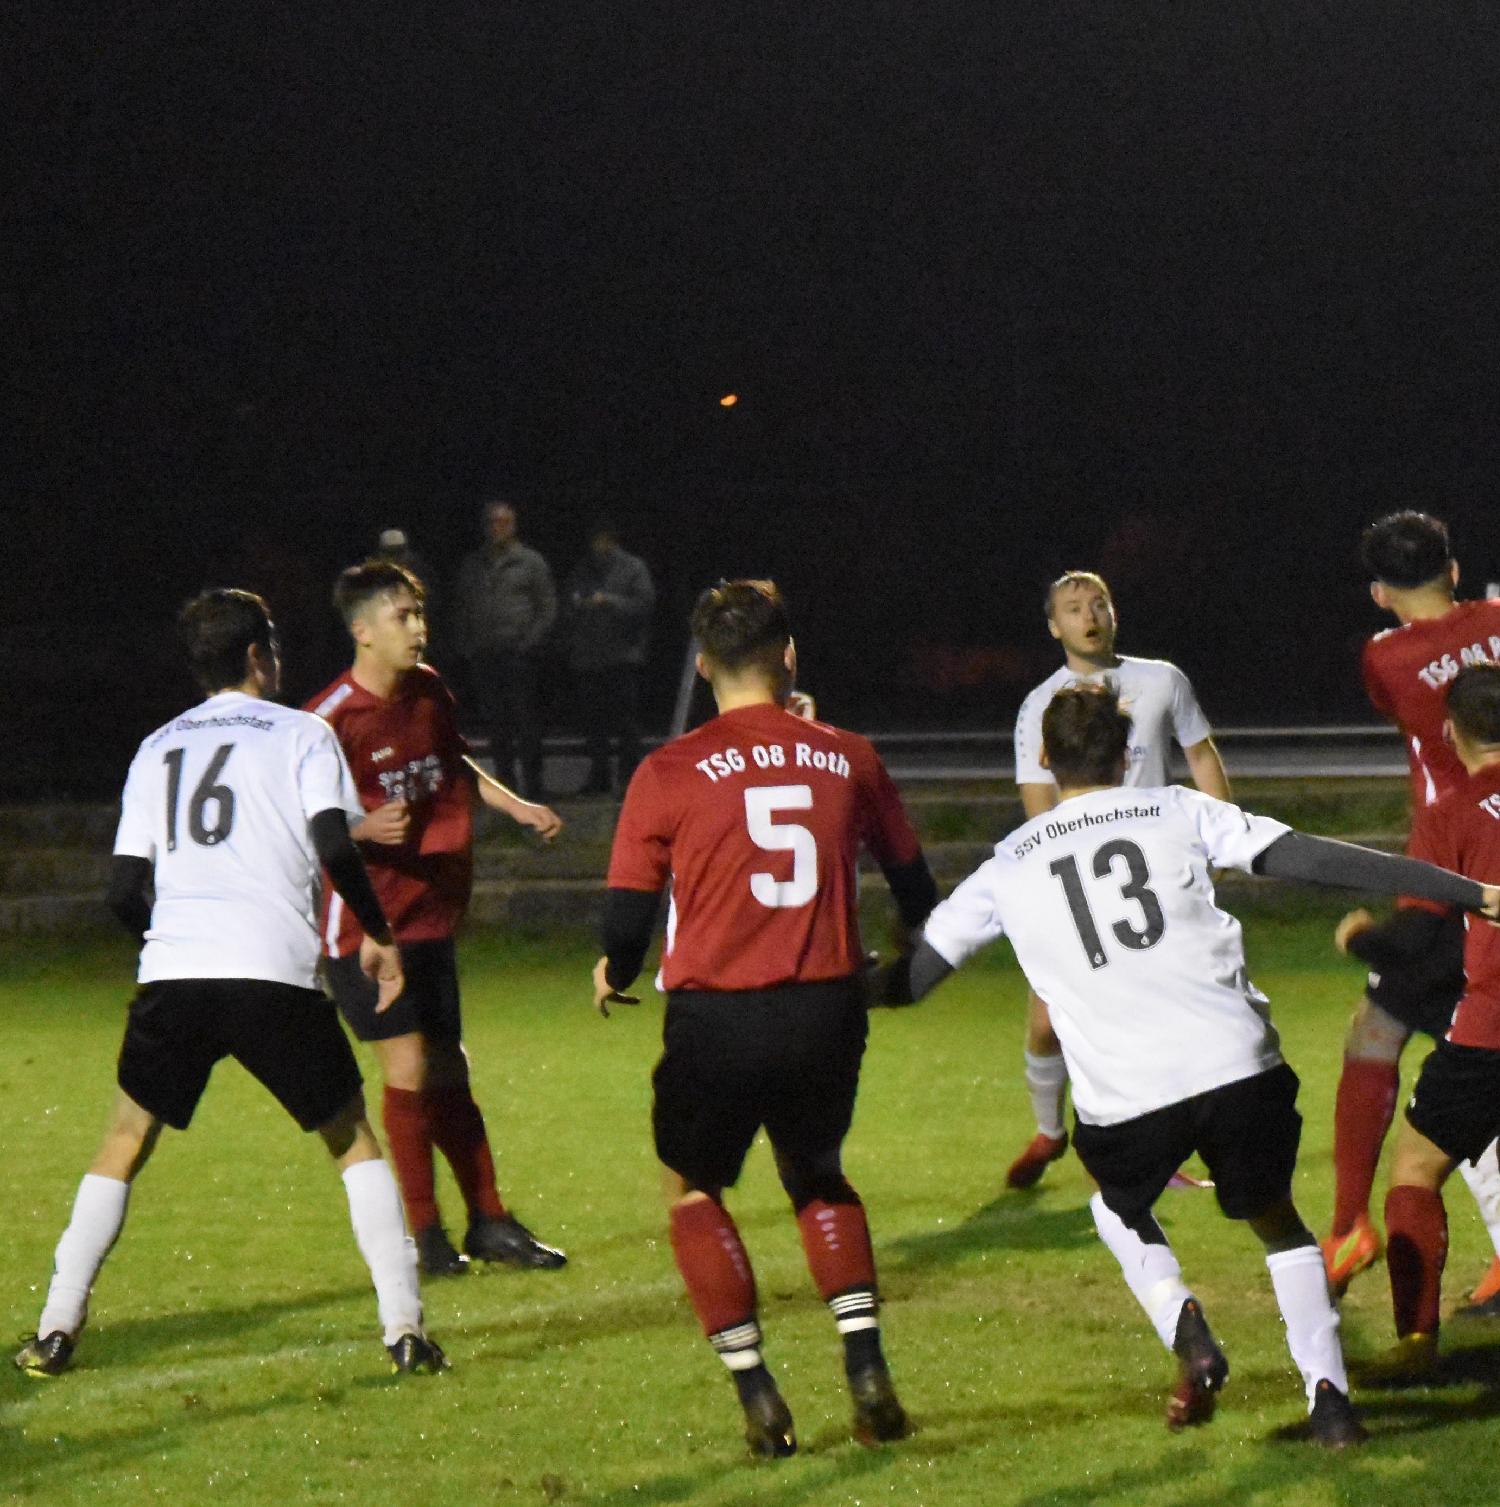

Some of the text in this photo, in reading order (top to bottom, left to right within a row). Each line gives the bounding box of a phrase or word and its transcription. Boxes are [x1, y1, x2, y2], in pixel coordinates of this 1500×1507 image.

[1418, 654, 1459, 690] TSG
[163, 741, 237, 855] 16
[695, 742, 851, 783] TSG 08 Roth
[743, 785, 819, 909] 5
[1014, 806, 1161, 859] SSV Oberhochstatt
[1048, 837, 1167, 972] 13
